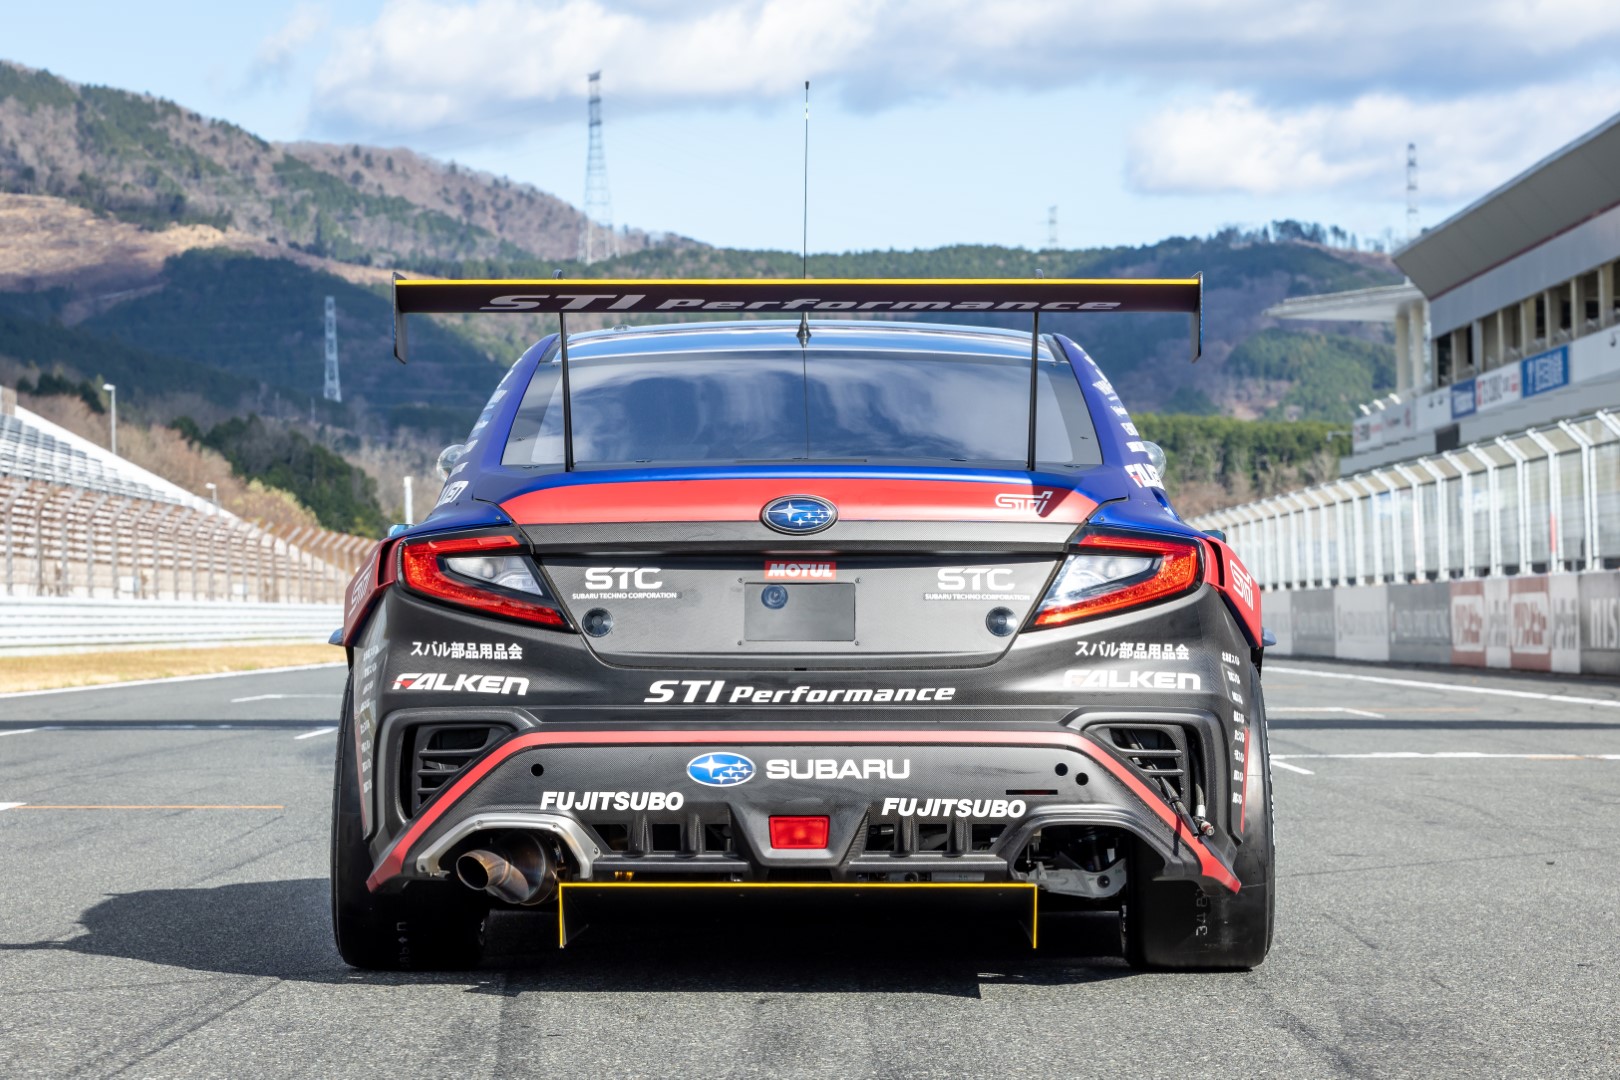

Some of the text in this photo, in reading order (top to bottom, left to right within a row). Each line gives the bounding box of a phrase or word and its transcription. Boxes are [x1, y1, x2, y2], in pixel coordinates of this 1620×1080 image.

[480, 294, 1123, 311] STI Performance
[585, 567, 663, 590] STC
[768, 563, 833, 578] MOTUL
[937, 568, 1015, 591] STC
[1590, 598, 1620, 648] MIS
[410, 641, 523, 660] スバル部品用品会
[1075, 641, 1190, 661] スバル部品用品会
[392, 673, 529, 696] FALKEN
[1062, 669, 1201, 690] FALKEN
[643, 680, 956, 704] STI Performance
[766, 758, 910, 780] SUBARU
[540, 791, 684, 811] FUJITSUBO
[881, 798, 1026, 818] FUJITSUBO
